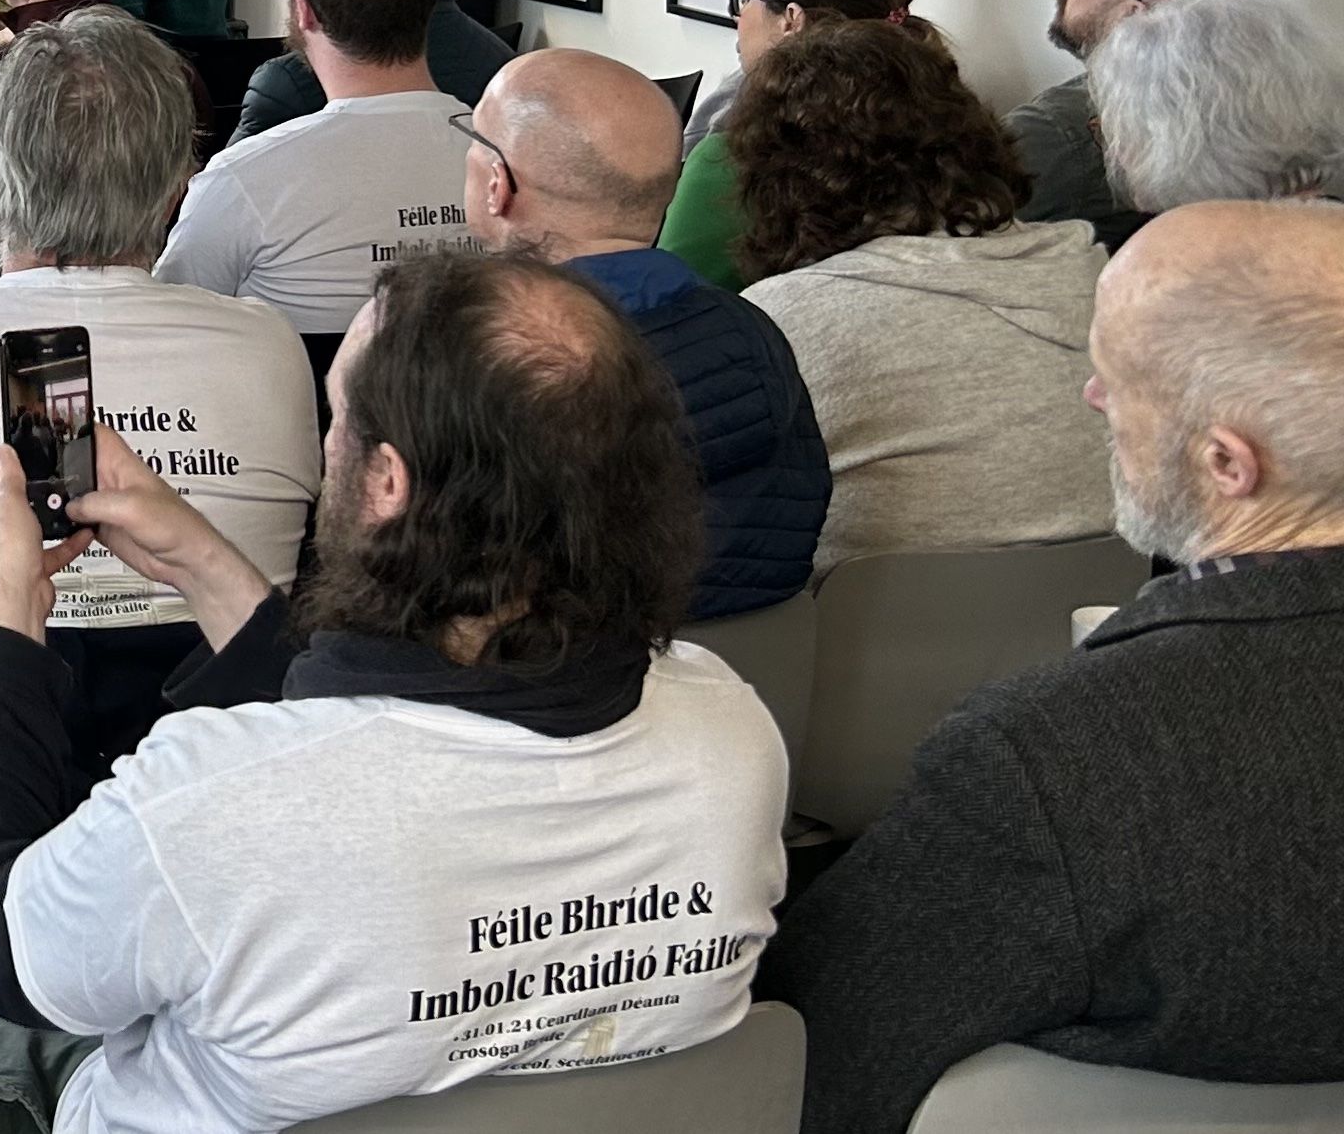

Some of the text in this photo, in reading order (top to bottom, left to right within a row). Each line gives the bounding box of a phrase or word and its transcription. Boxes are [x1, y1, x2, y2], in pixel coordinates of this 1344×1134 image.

[397, 205, 439, 228] Féile
[94, 406, 198, 433] hríde &
[167, 447, 240, 476] Fáilte
[70, 605, 114, 619] Raidió
[114, 600, 151, 614] Fáilte
[468, 880, 714, 954] Féile Bhríde &
[407, 933, 749, 1023] Imbolc Raidió Fáilte
[620, 992, 681, 1012] Déanta
[448, 1042, 520, 1063] Crosóga
